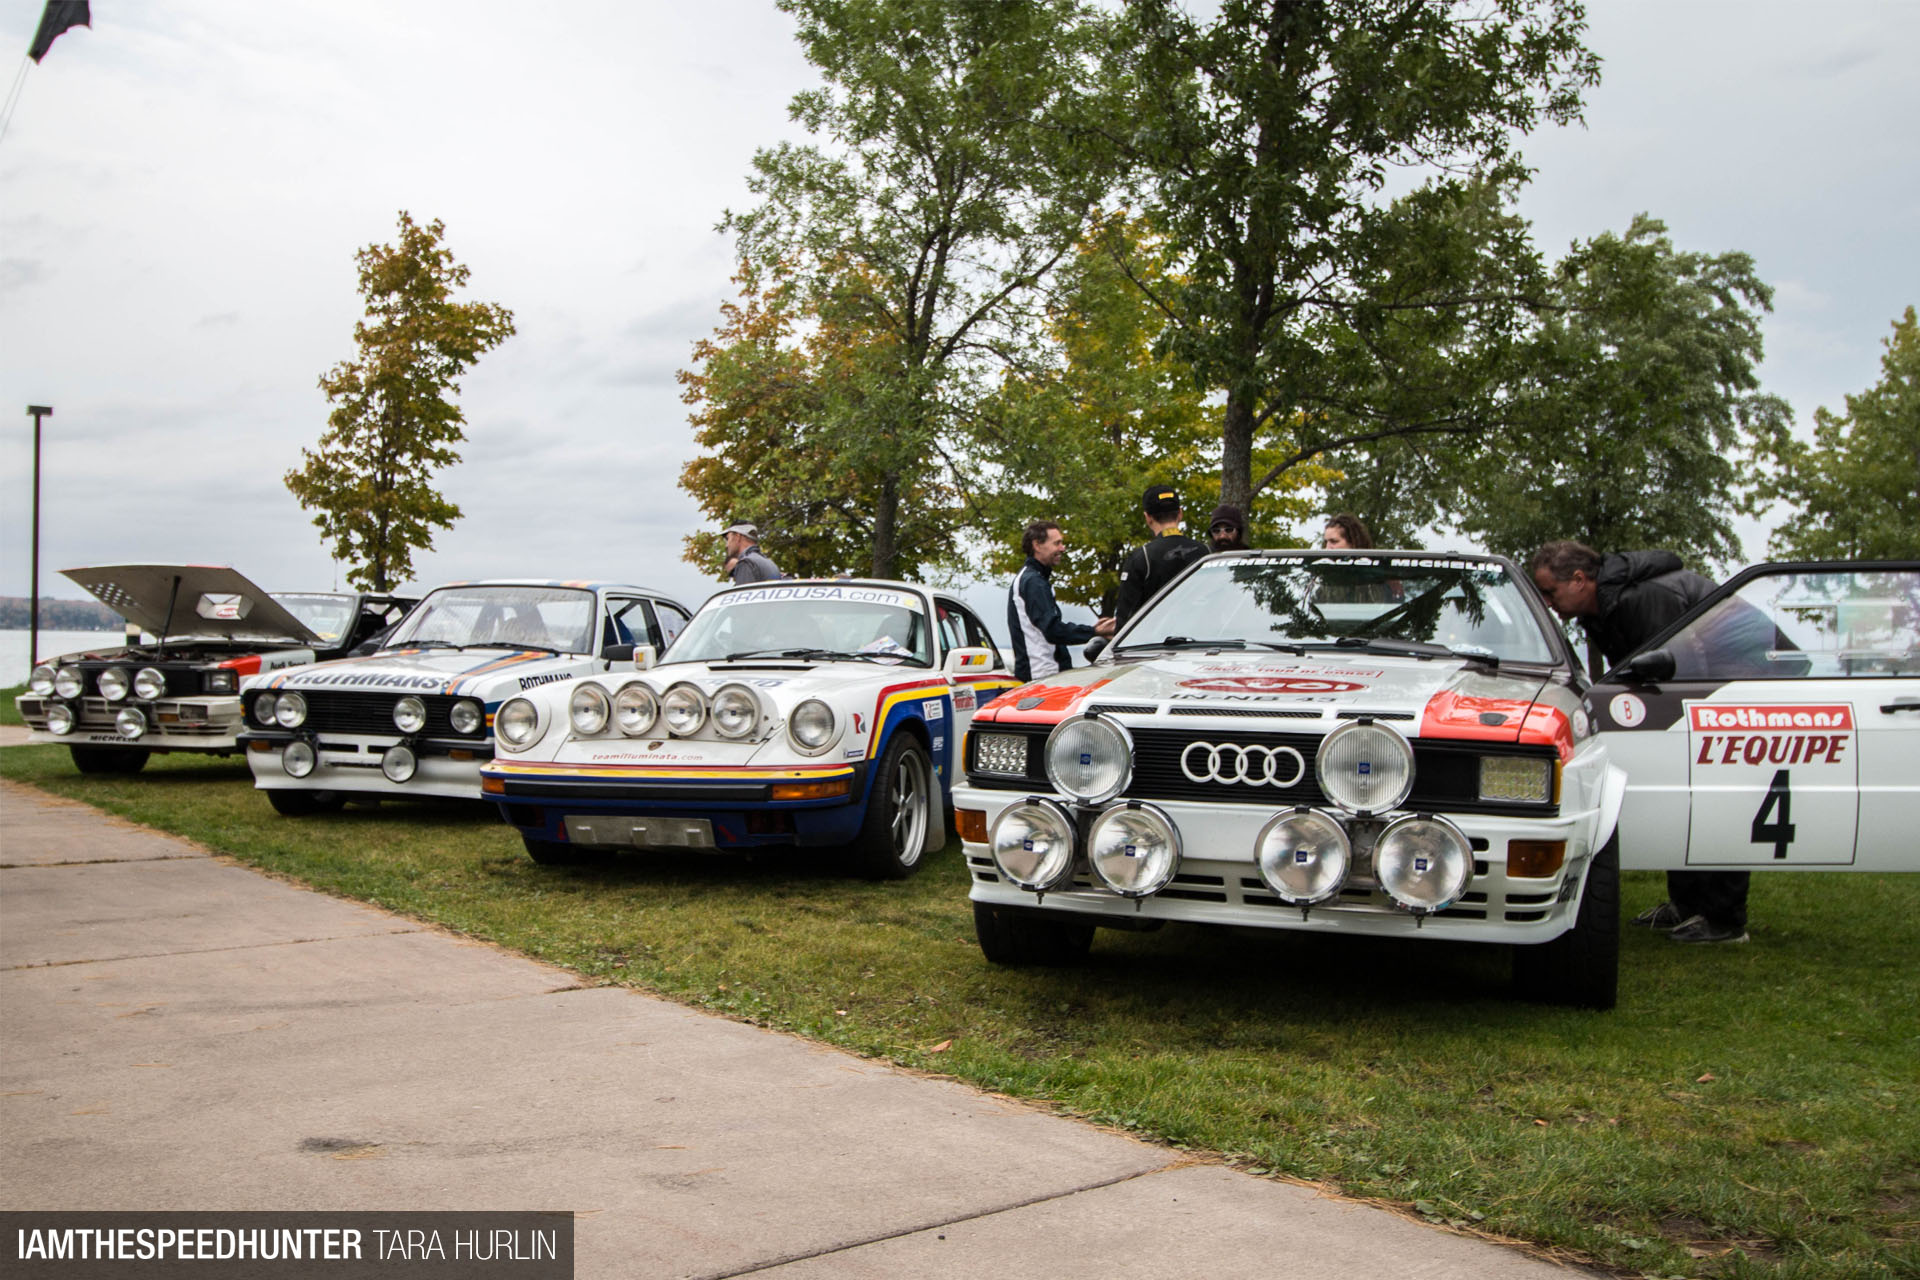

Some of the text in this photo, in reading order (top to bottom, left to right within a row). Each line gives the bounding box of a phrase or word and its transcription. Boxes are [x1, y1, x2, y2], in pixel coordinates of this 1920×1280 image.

[1201, 557, 1304, 568] MICHELIN
[1391, 559, 1503, 572] MICHELIN
[719, 587, 899, 606] BRAIDUSA.com
[1623, 700, 1632, 720] B
[1698, 708, 1844, 728] Rothmans
[592, 752, 704, 762] teamilluminata.com
[1696, 735, 1849, 766] L'EQUIPE
[1750, 769, 1796, 859] 4
